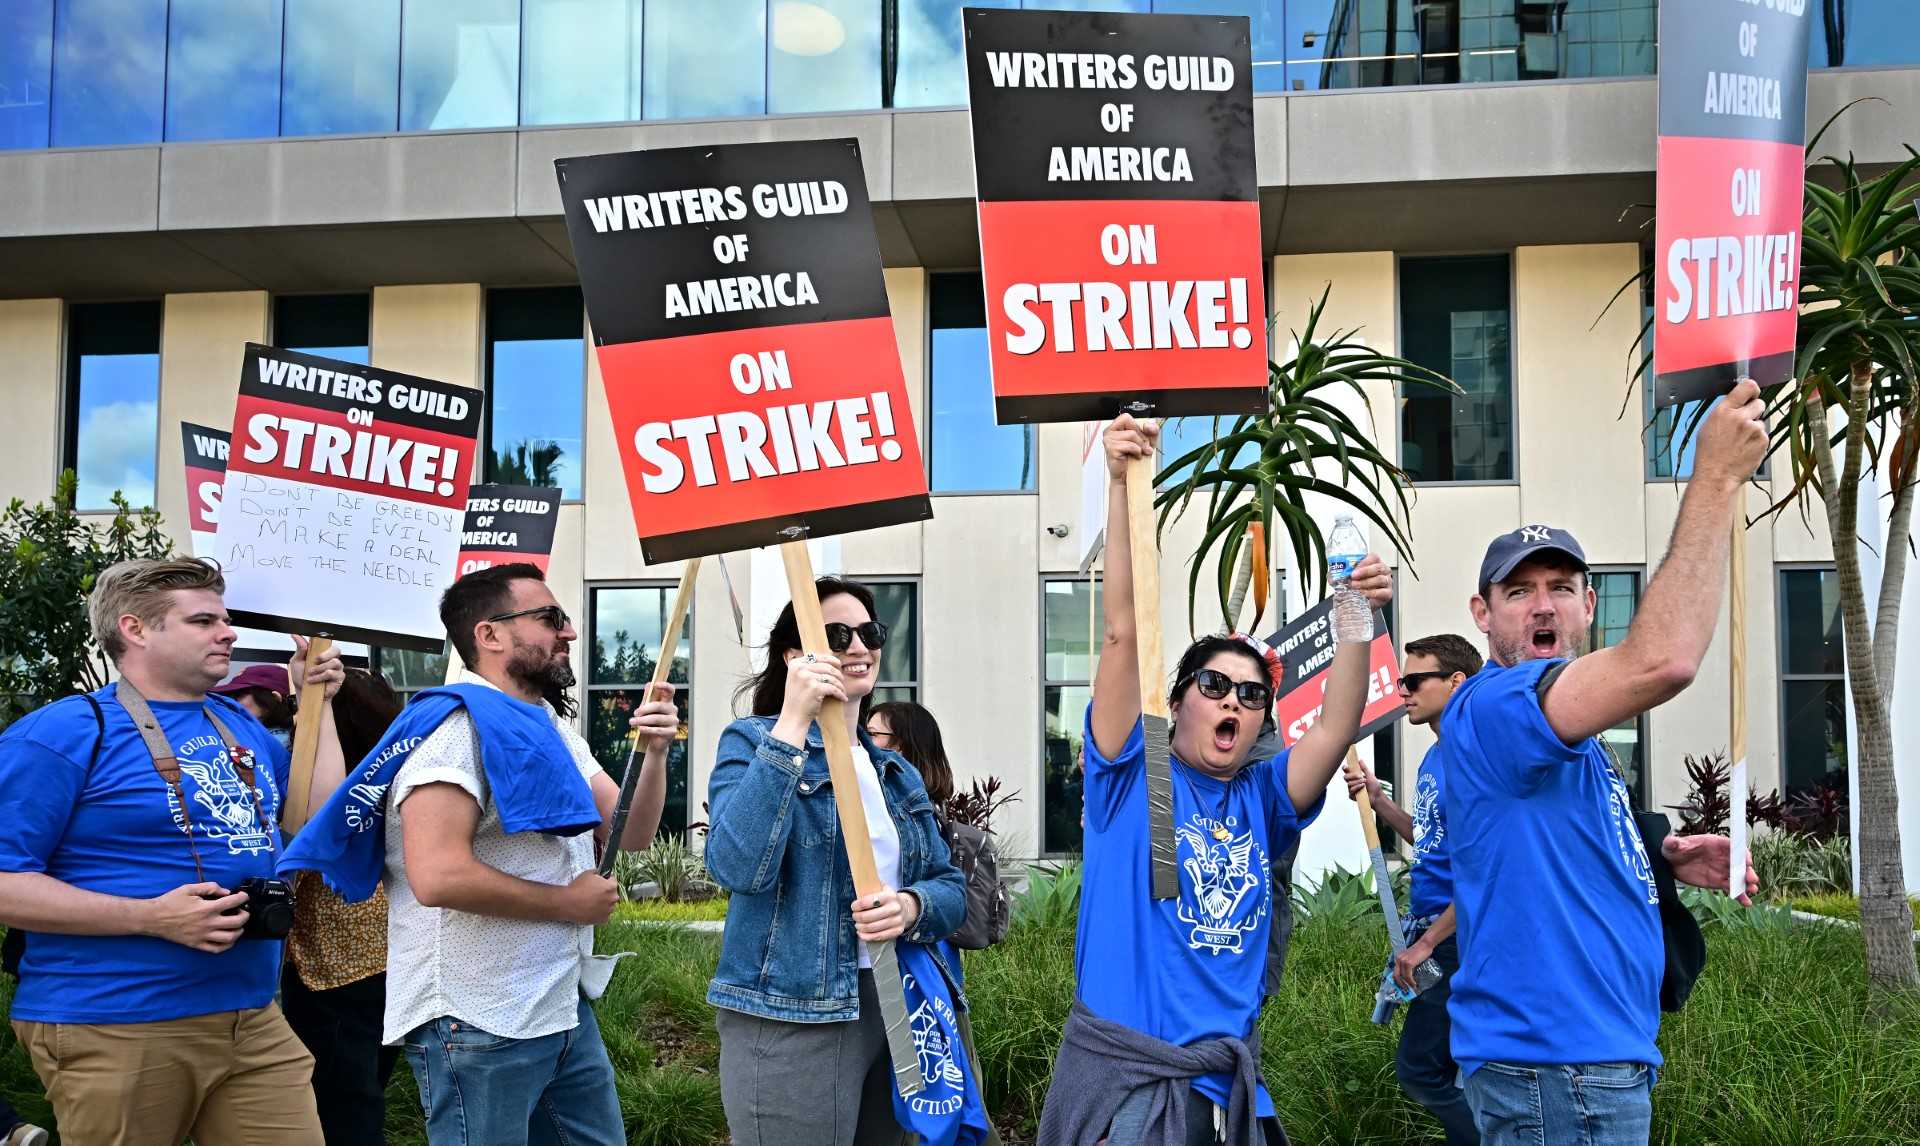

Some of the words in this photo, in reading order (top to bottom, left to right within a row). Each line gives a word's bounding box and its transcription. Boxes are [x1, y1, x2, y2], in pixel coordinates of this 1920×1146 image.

[1739, 21, 1758, 57] OF
[985, 52, 1138, 89] WRITERS
[1143, 55, 1235, 92] GUILD
[1704, 71, 1781, 120] AMERICA
[1100, 103, 1134, 133] OF
[1047, 147, 1194, 182] AMERICA
[584, 185, 747, 233] WRITERS
[752, 180, 849, 219] GUILD
[1731, 167, 1761, 217] ON
[713, 234, 749, 264] OF
[1100, 223, 1158, 266] ON
[665, 272, 819, 319] AMERICA
[1666, 231, 1797, 326] STRIKE!
[1003, 278, 1253, 356] STRIKE!
[258, 357, 383, 405] WRITERS
[388, 385, 468, 421] GUILD
[729, 350, 793, 395] ON
[347, 407, 374, 427] ON
[243, 412, 460, 498] STRIKE!
[634, 391, 902, 494] STRIKE!
[337, 493, 364, 509] BE
[376, 501, 452, 533] GREEDY
[466, 498, 500, 512] TERS
[503, 498, 550, 515] GUILD
[476, 515, 494, 527] OF
[258, 519, 349, 550] MAKE
[364, 539, 375, 553] A
[390, 545, 440, 565] DEAL
[328, 512, 353, 527] BE
[372, 518, 430, 542] EVIL
[460, 531, 518, 546] MERICA
[224, 543, 296, 573] MOVE
[308, 556, 346, 574] THE
[363, 562, 435, 587] NEEDLE
[1274, 615, 1327, 657] WRITERS
[1314, 632, 1329, 648] OF
[180, 735, 218, 755] GUILD
[1204, 933, 1232, 944] WEST
[912, 1095, 962, 1115] GUILD
